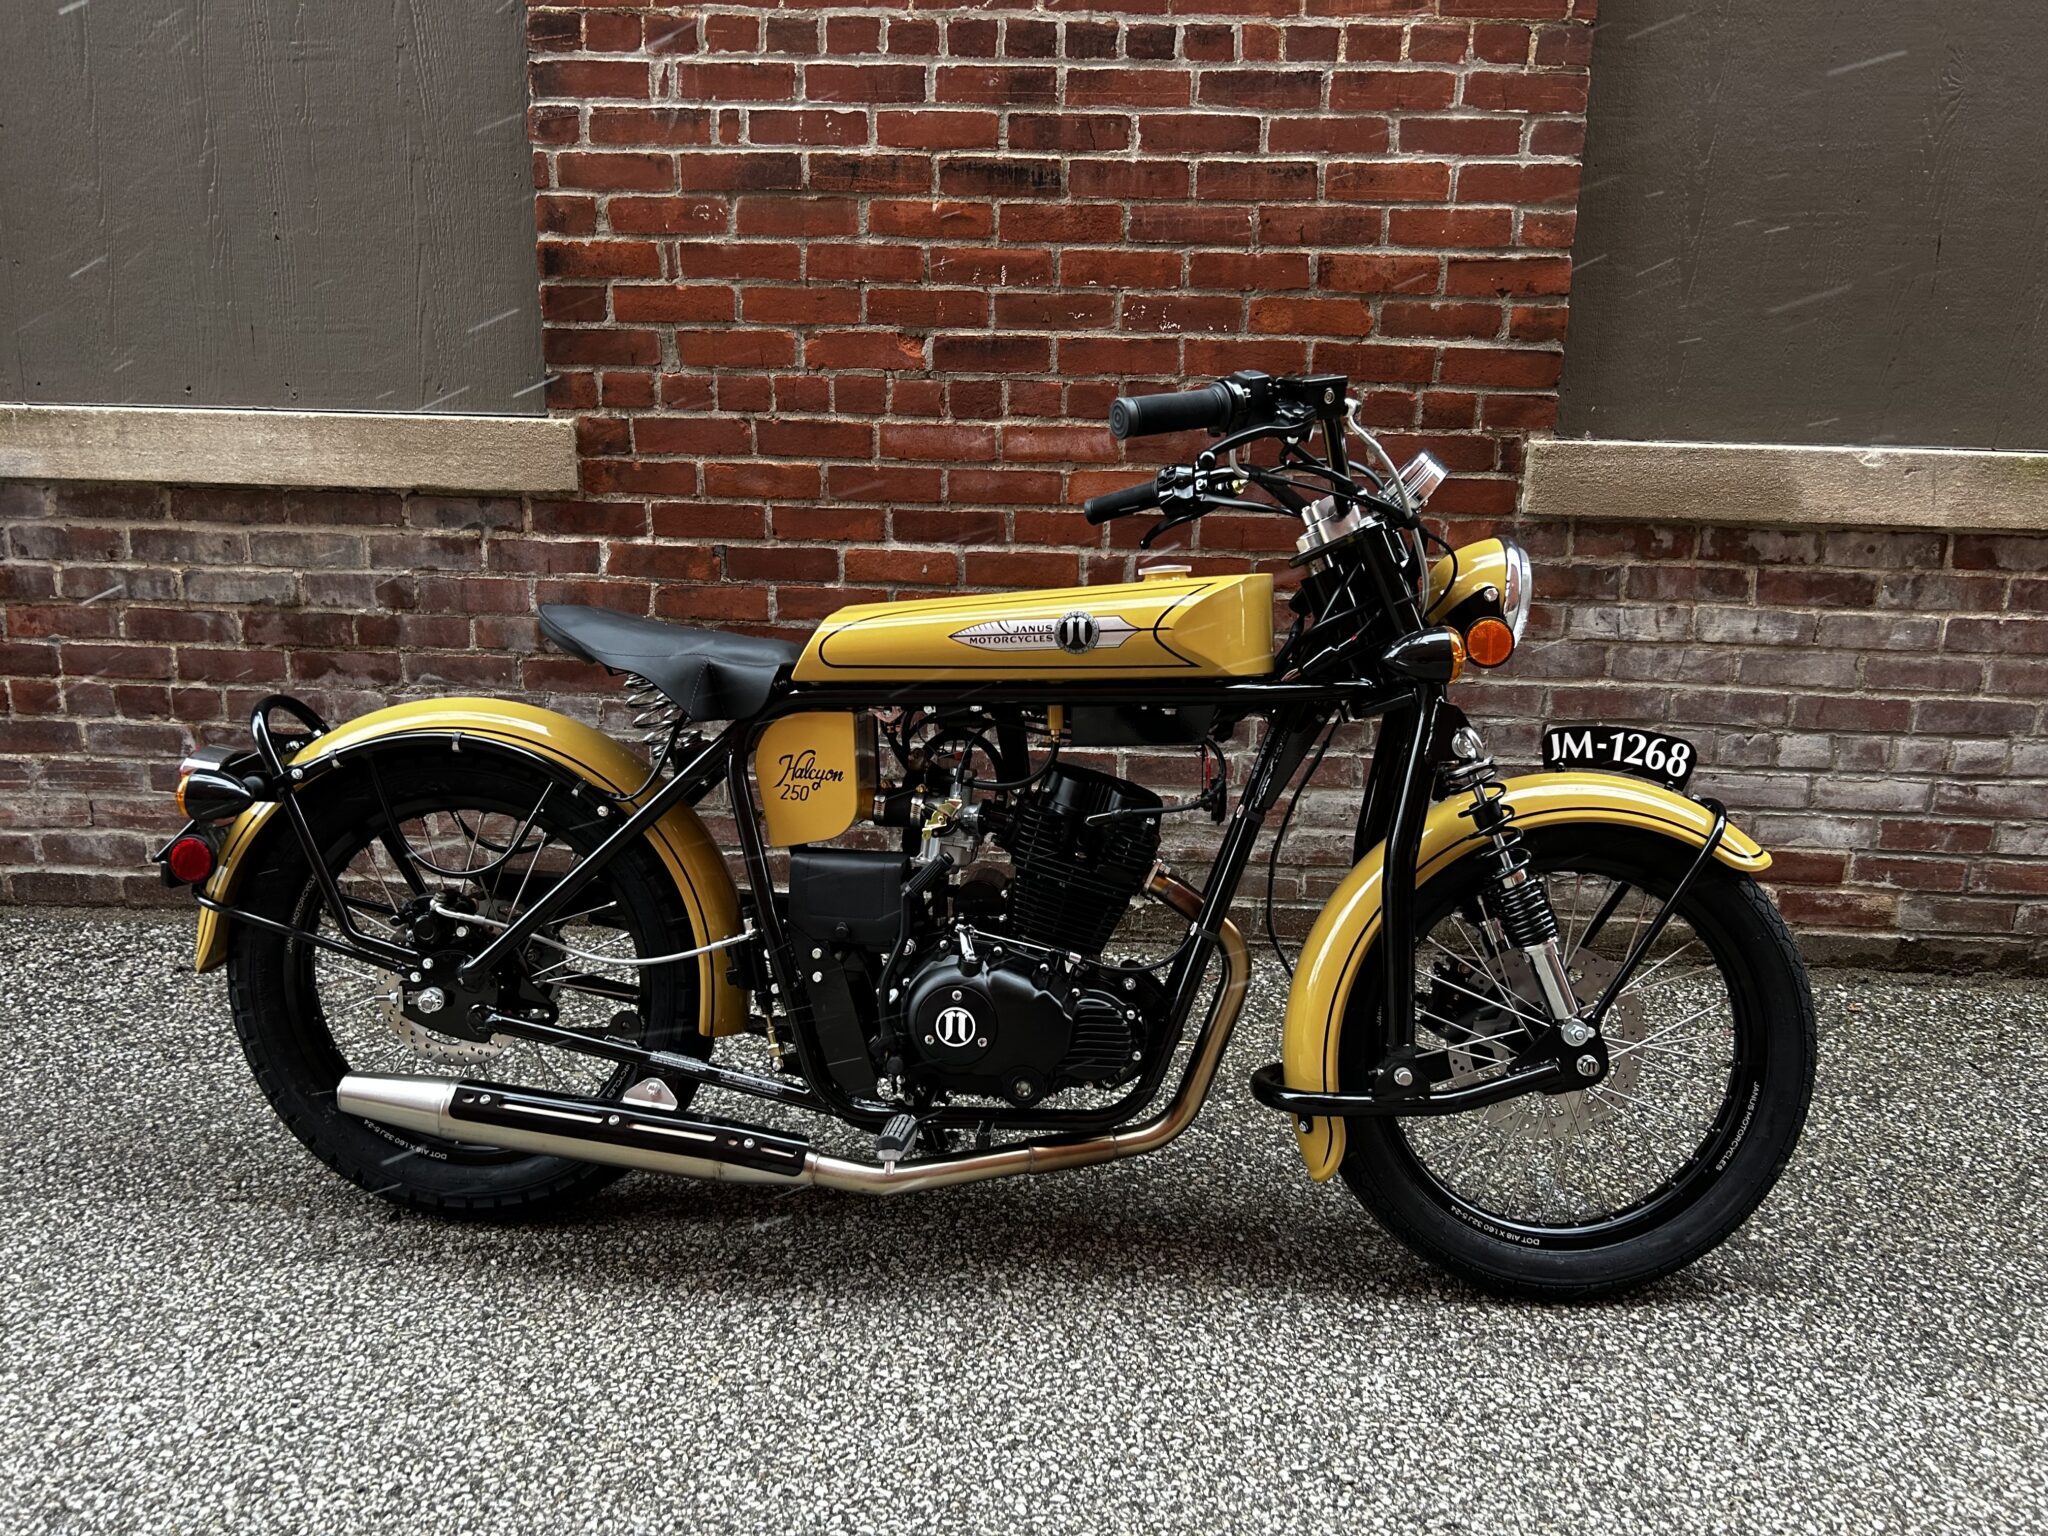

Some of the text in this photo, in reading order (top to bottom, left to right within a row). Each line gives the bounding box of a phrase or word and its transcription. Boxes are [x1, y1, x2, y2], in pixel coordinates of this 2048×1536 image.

[1013, 624, 1053, 634] JANUS
[969, 635, 1054, 645] MOTORCYCLES
[1551, 730, 1691, 778] JM-1268
[773, 749, 844, 791] Halcyon
[780, 784, 810, 801] 250
[1716, 1081, 1760, 1171] JANUS MOTORCYCLES
[429, 1151, 448, 1160] DOT
[1521, 1237, 1540, 1246] DOT
